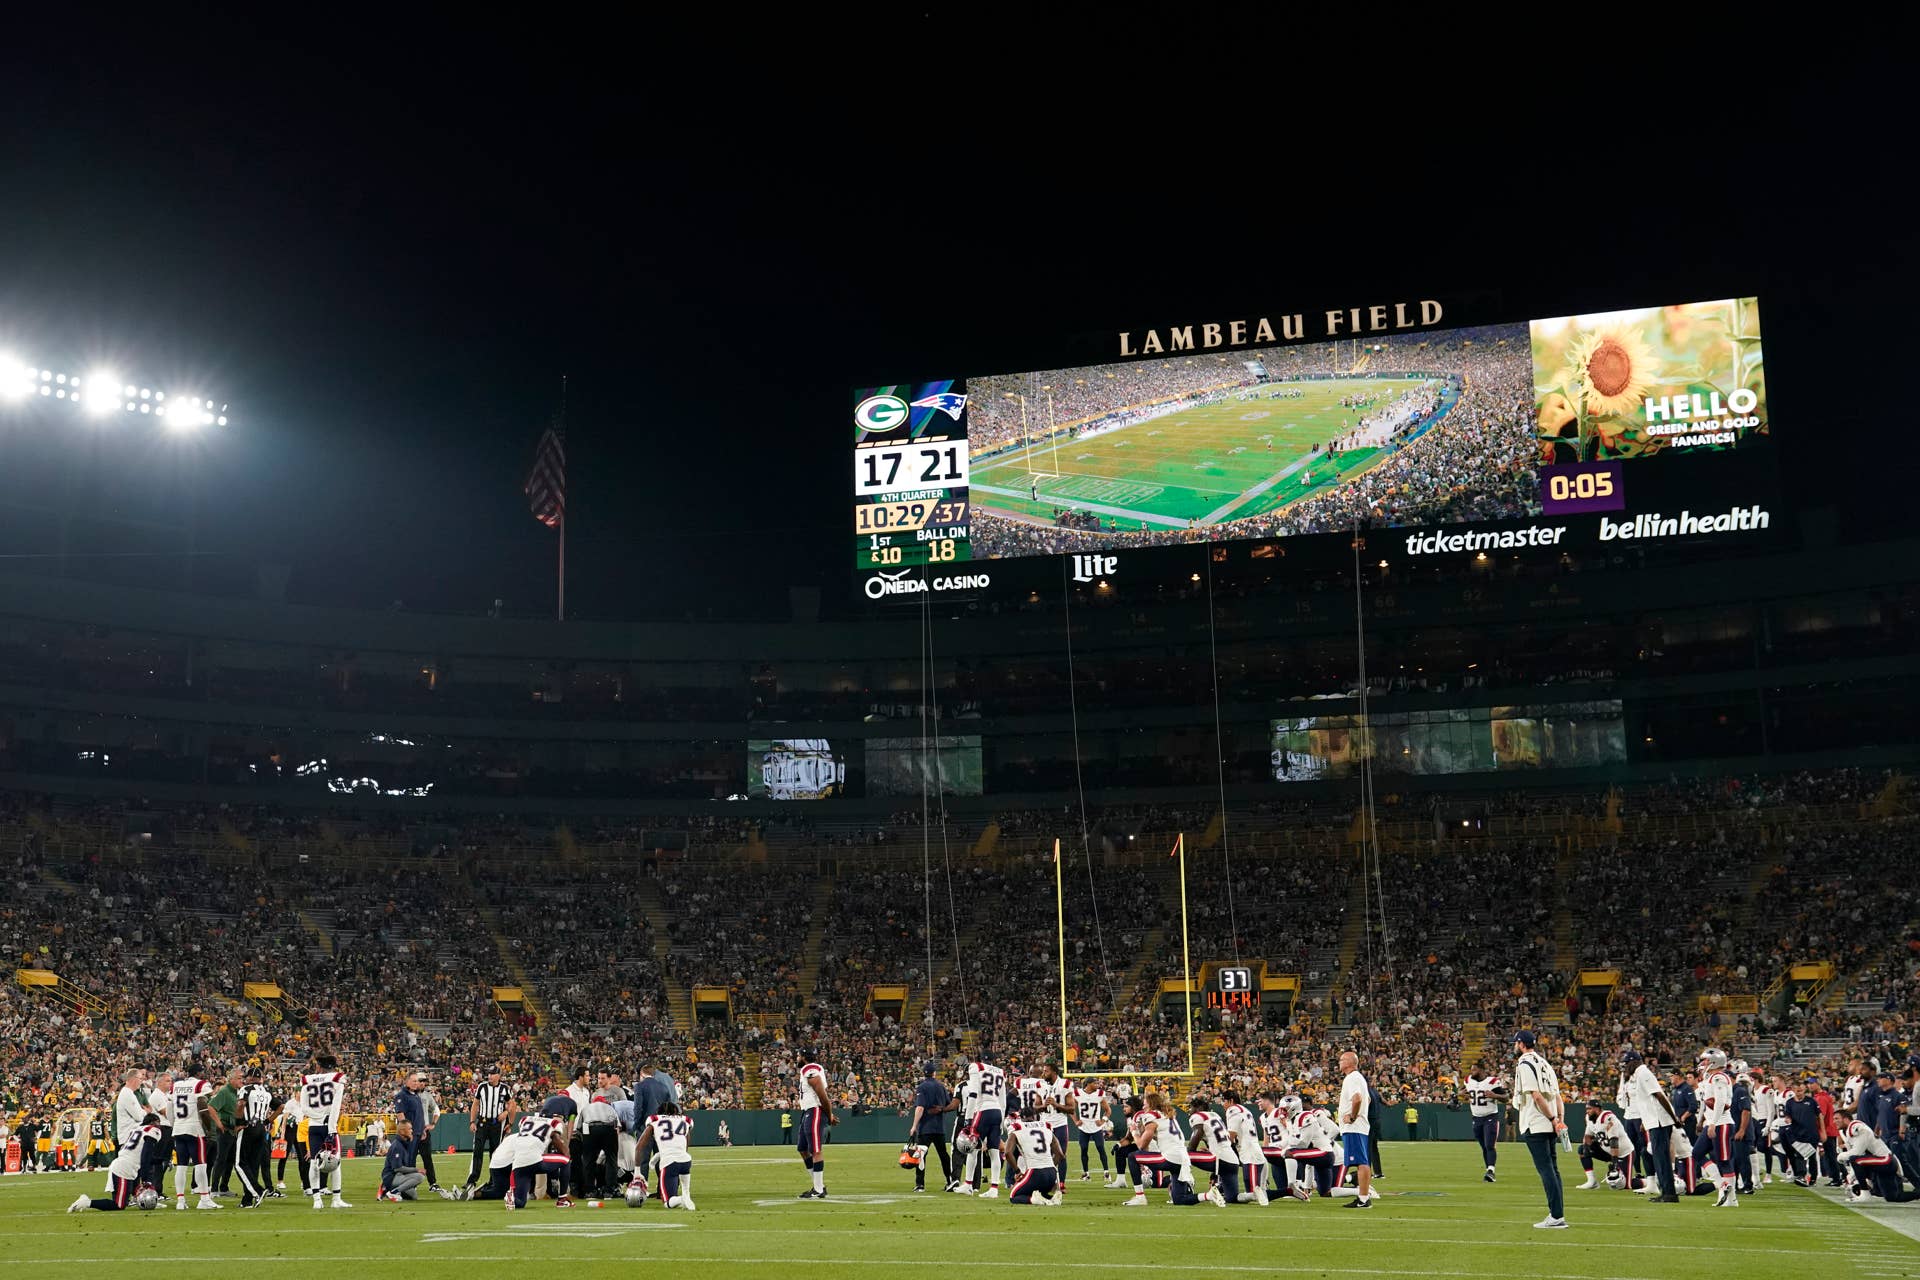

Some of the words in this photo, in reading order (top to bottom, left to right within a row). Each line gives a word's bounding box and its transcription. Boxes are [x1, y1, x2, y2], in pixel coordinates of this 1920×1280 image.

[1119, 314, 1305, 357] LAMBEAU
[1325, 299, 1443, 336] FIELD
[1645, 388, 1758, 422] HELLO
[1646, 422, 1688, 436] GREEN
[1691, 420, 1720, 432] AND
[1723, 416, 1760, 429] GOLD
[1671, 432, 1735, 447] FANATICS!
[864, 452, 902, 487] 17
[920, 447, 962, 482] 21
[881, 492, 899, 503] 4TH
[901, 489, 944, 502] QUARTER
[1550, 472, 1614, 501] 0:05
[859, 503, 925, 529] 10:29
[870, 533, 891, 550] 1ST
[916, 528, 946, 542] BALL
[948, 526, 966, 539] ON
[1405, 524, 1566, 555] ticketmaster
[928, 539, 955, 562] 18
[1072, 554, 1118, 582] Lite
[865, 576, 928, 599] ONEIDA
[932, 574, 990, 591] CASINO
[1224, 971, 1247, 989] 37
[306, 1082, 334, 1108] 26
[981, 1072, 1004, 1096] 28
[176, 1095, 189, 1119] 5
[1080, 1102, 1099, 1119] 27
[518, 1121, 551, 1143] 24
[657, 1119, 687, 1141] 34
[1030, 1129, 1047, 1154] 3
